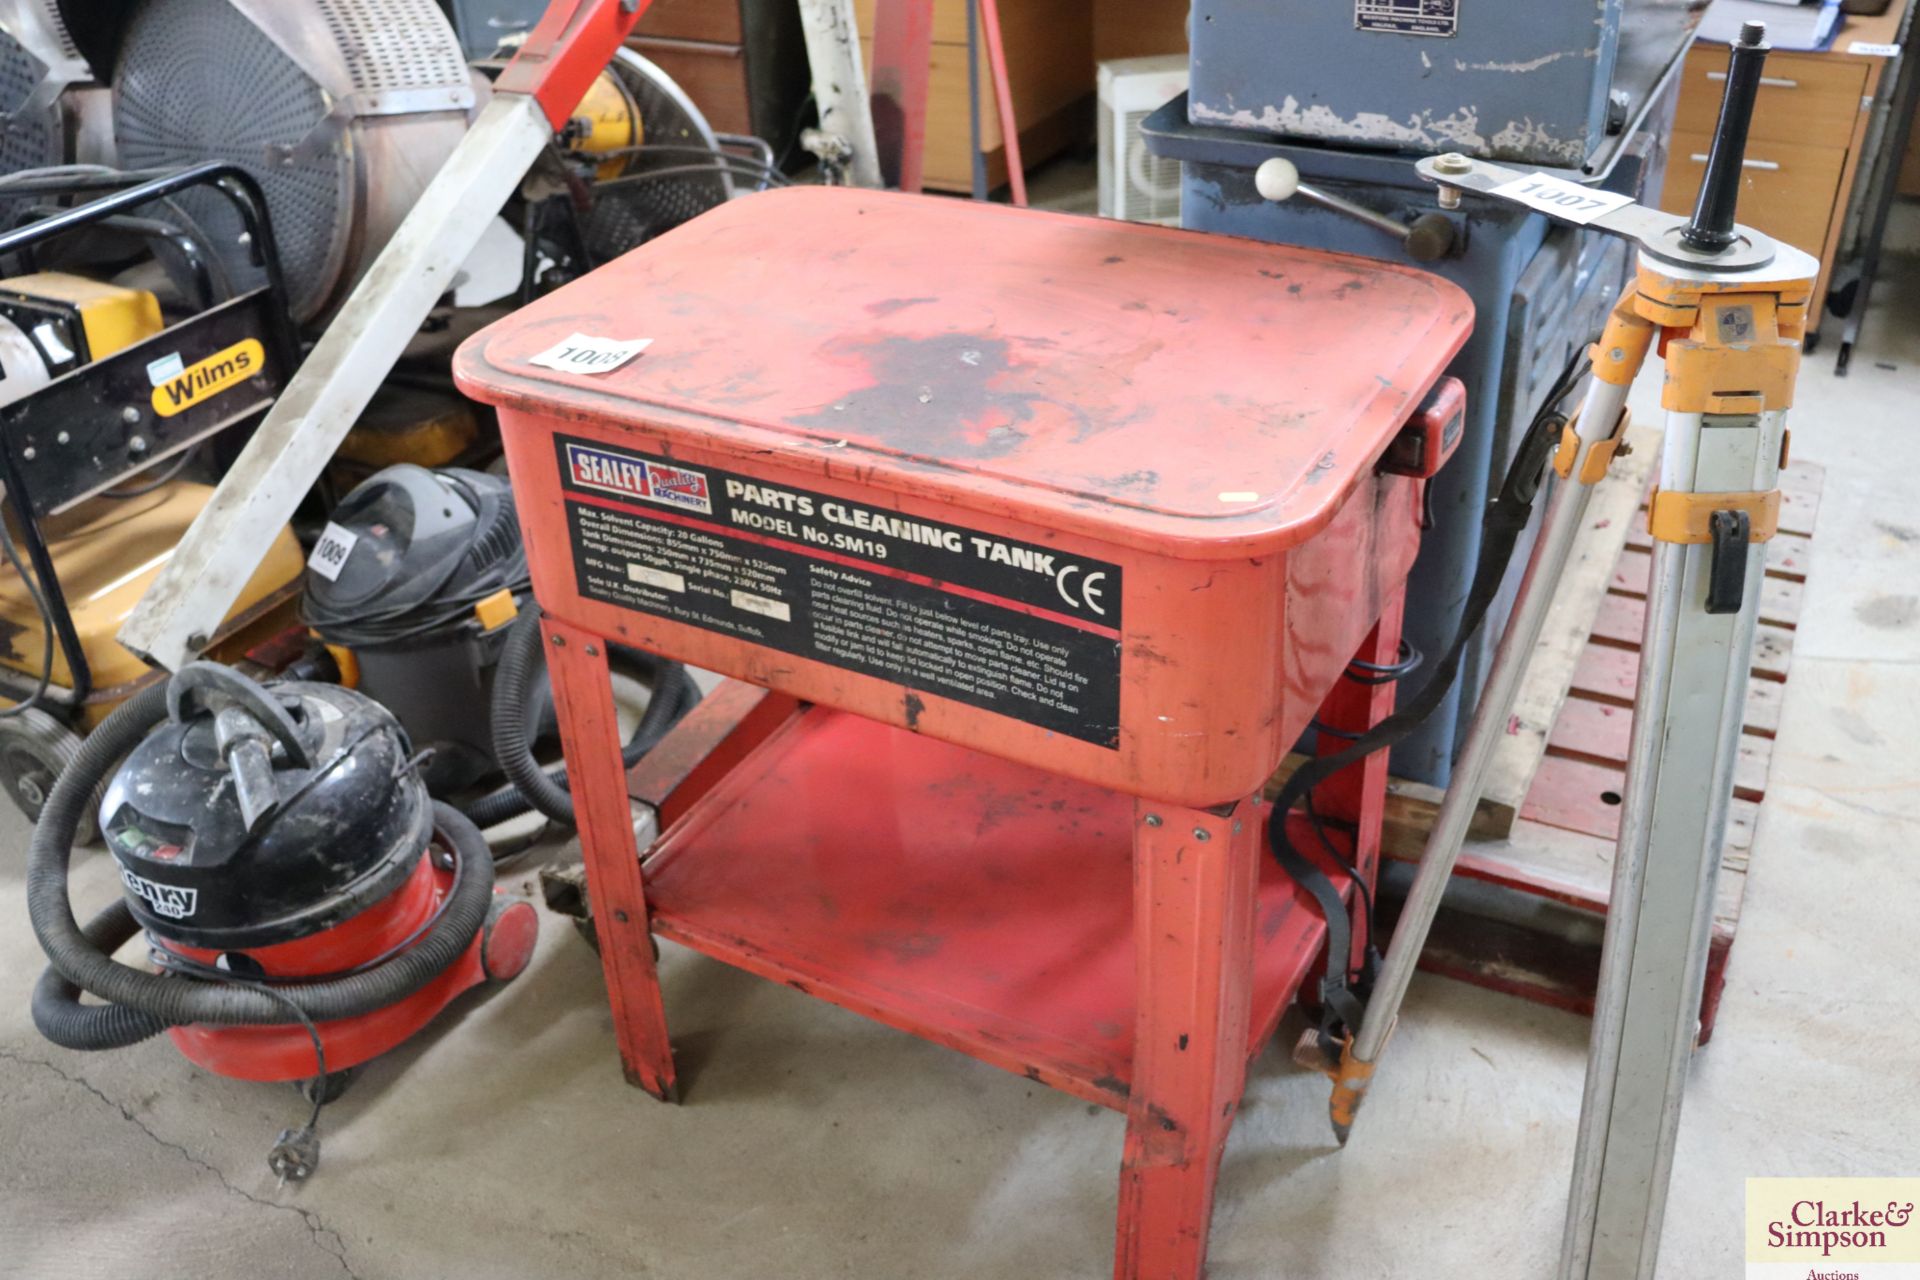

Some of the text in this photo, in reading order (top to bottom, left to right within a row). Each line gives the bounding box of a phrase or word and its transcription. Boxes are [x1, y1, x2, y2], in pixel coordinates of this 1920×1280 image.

[1520, 182, 1608, 211] 1007
[165, 351, 251, 406] Wilms
[558, 347, 629, 365] 1008
[577, 452, 641, 492] SEALEY
[648, 469, 700, 493] Quality
[653, 487, 707, 508] MACHINERY
[579, 517, 787, 575] Overall Dimensions: 855mm x 750mm x 525mm
[599, 511, 633, 526] Solvent
[634, 520, 675, 537] Capacity:
[676, 528, 687, 540] 20
[689, 533, 724, 548] Gallons
[725, 479, 1054, 575] PARTS CLEANING TANK
[730, 508, 887, 559] MODEL No.SM19
[581, 529, 600, 539] Tank
[655, 546, 689, 561] 250mm
[690, 555, 697, 563] x
[698, 556, 732, 571] 735mm
[740, 567, 775, 582] 520mm
[610, 545, 641, 560] output
[673, 560, 701, 575] Single
[759, 583, 782, 595] 50Hz
[809, 564, 872, 586] Safety Advice
[687, 582, 711, 595] Serial
[810, 576, 821, 587] Do
[823, 581, 836, 591] not
[836, 585, 863, 597] overfill
[909, 604, 917, 613] to
[918, 607, 933, 617] just
[934, 610, 958, 622] below
[960, 617, 979, 628] level
[980, 623, 989, 632] of
[990, 627, 1011, 639] parts
[1033, 639, 1050, 649] Use
[1051, 645, 1069, 657] only
[810, 589, 831, 601] parts
[831, 594, 864, 610] cleaning
[885, 607, 898, 618] Do
[899, 611, 913, 623] not
[913, 616, 944, 631] operate
[945, 625, 966, 636] while
[967, 632, 1003, 649] smoking.
[1006, 641, 1019, 652] Do
[1020, 646, 1033, 656] not
[1035, 652, 1067, 666] operate
[820, 622, 845, 635] fusible
[846, 628, 860, 639] link
[861, 633, 876, 643] and
[876, 637, 891, 647] will
[905, 647, 956, 667] automatically
[957, 660, 966, 670] to
[967, 665, 1008, 682] extinguish
[1036, 683, 1049, 694] Do
[1050, 688, 1063, 700] not
[830, 604, 848, 615] heat
[848, 610, 880, 623] sources
[880, 618, 899, 628] such
[976, 645, 999, 657] open
[1043, 664, 1072, 679] Should
[1074, 673, 1088, 685] fire
[834, 616, 843, 625] in
[843, 619, 864, 631] parts
[908, 636, 921, 646] not
[922, 640, 953, 656] attempt
[954, 648, 963, 658] to
[964, 653, 987, 664] move
[988, 659, 1009, 673] parts
[1010, 665, 1041, 681] cleaner.
[1044, 675, 1056, 687] Lid
[1058, 680, 1066, 690] is
[1067, 684, 1079, 695] on
[813, 631, 838, 645] modify
[839, 638, 848, 647] or
[850, 642, 865, 651] jam
[866, 644, 875, 654] lid
[876, 647, 885, 657] to
[886, 651, 905, 663] keep
[917, 660, 944, 673] locked
[945, 667, 953, 676] in
[953, 671, 975, 683] open
[976, 676, 1008, 693] position.
[1010, 687, 1037, 701] Check
[1039, 696, 1054, 707] and
[1056, 702, 1078, 714] clean
[868, 656, 884, 666] Use
[885, 662, 902, 673] only
[903, 666, 911, 675] in
[912, 669, 918, 677] a
[920, 671, 935, 681] well
[937, 676, 974, 692] ventilated
[124, 869, 197, 915] enry
[156, 900, 181, 916] 240
